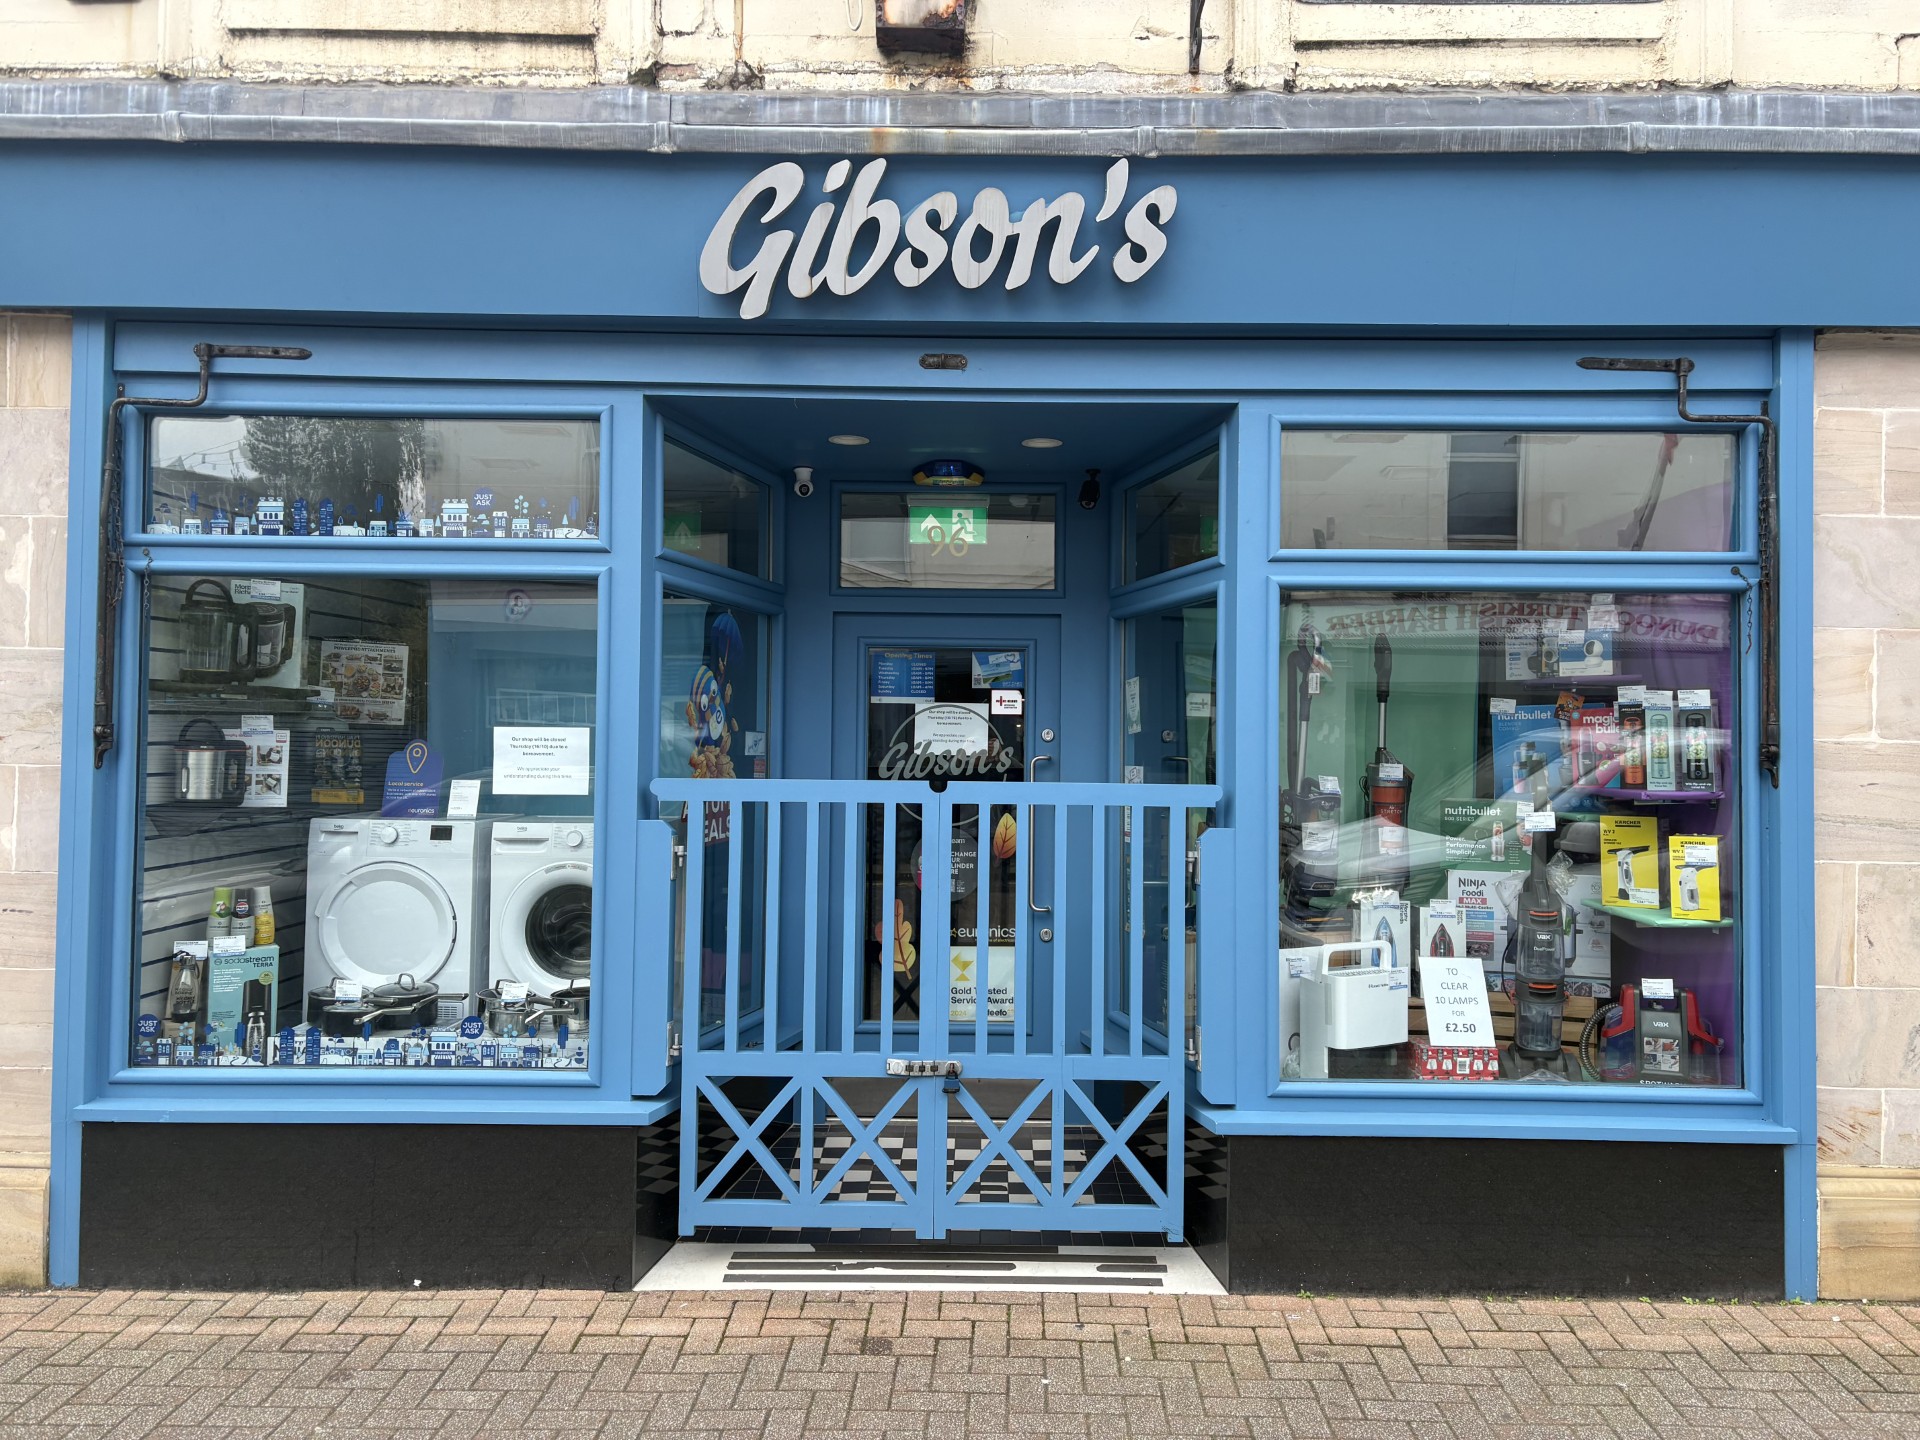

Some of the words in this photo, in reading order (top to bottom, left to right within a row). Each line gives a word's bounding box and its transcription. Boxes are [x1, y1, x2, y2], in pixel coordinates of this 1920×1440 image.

[699, 157, 1178, 319] Gibson's
[927, 525, 969, 558] 96
[878, 740, 1014, 781] Gibson's
[1444, 806, 1500, 816] nutribullet
[1458, 876, 1486, 889] NINJA
[224, 956, 275, 965] sodastream
[1448, 997, 1478, 1005] LAMPS
[1445, 1023, 1476, 1033] £2.50
